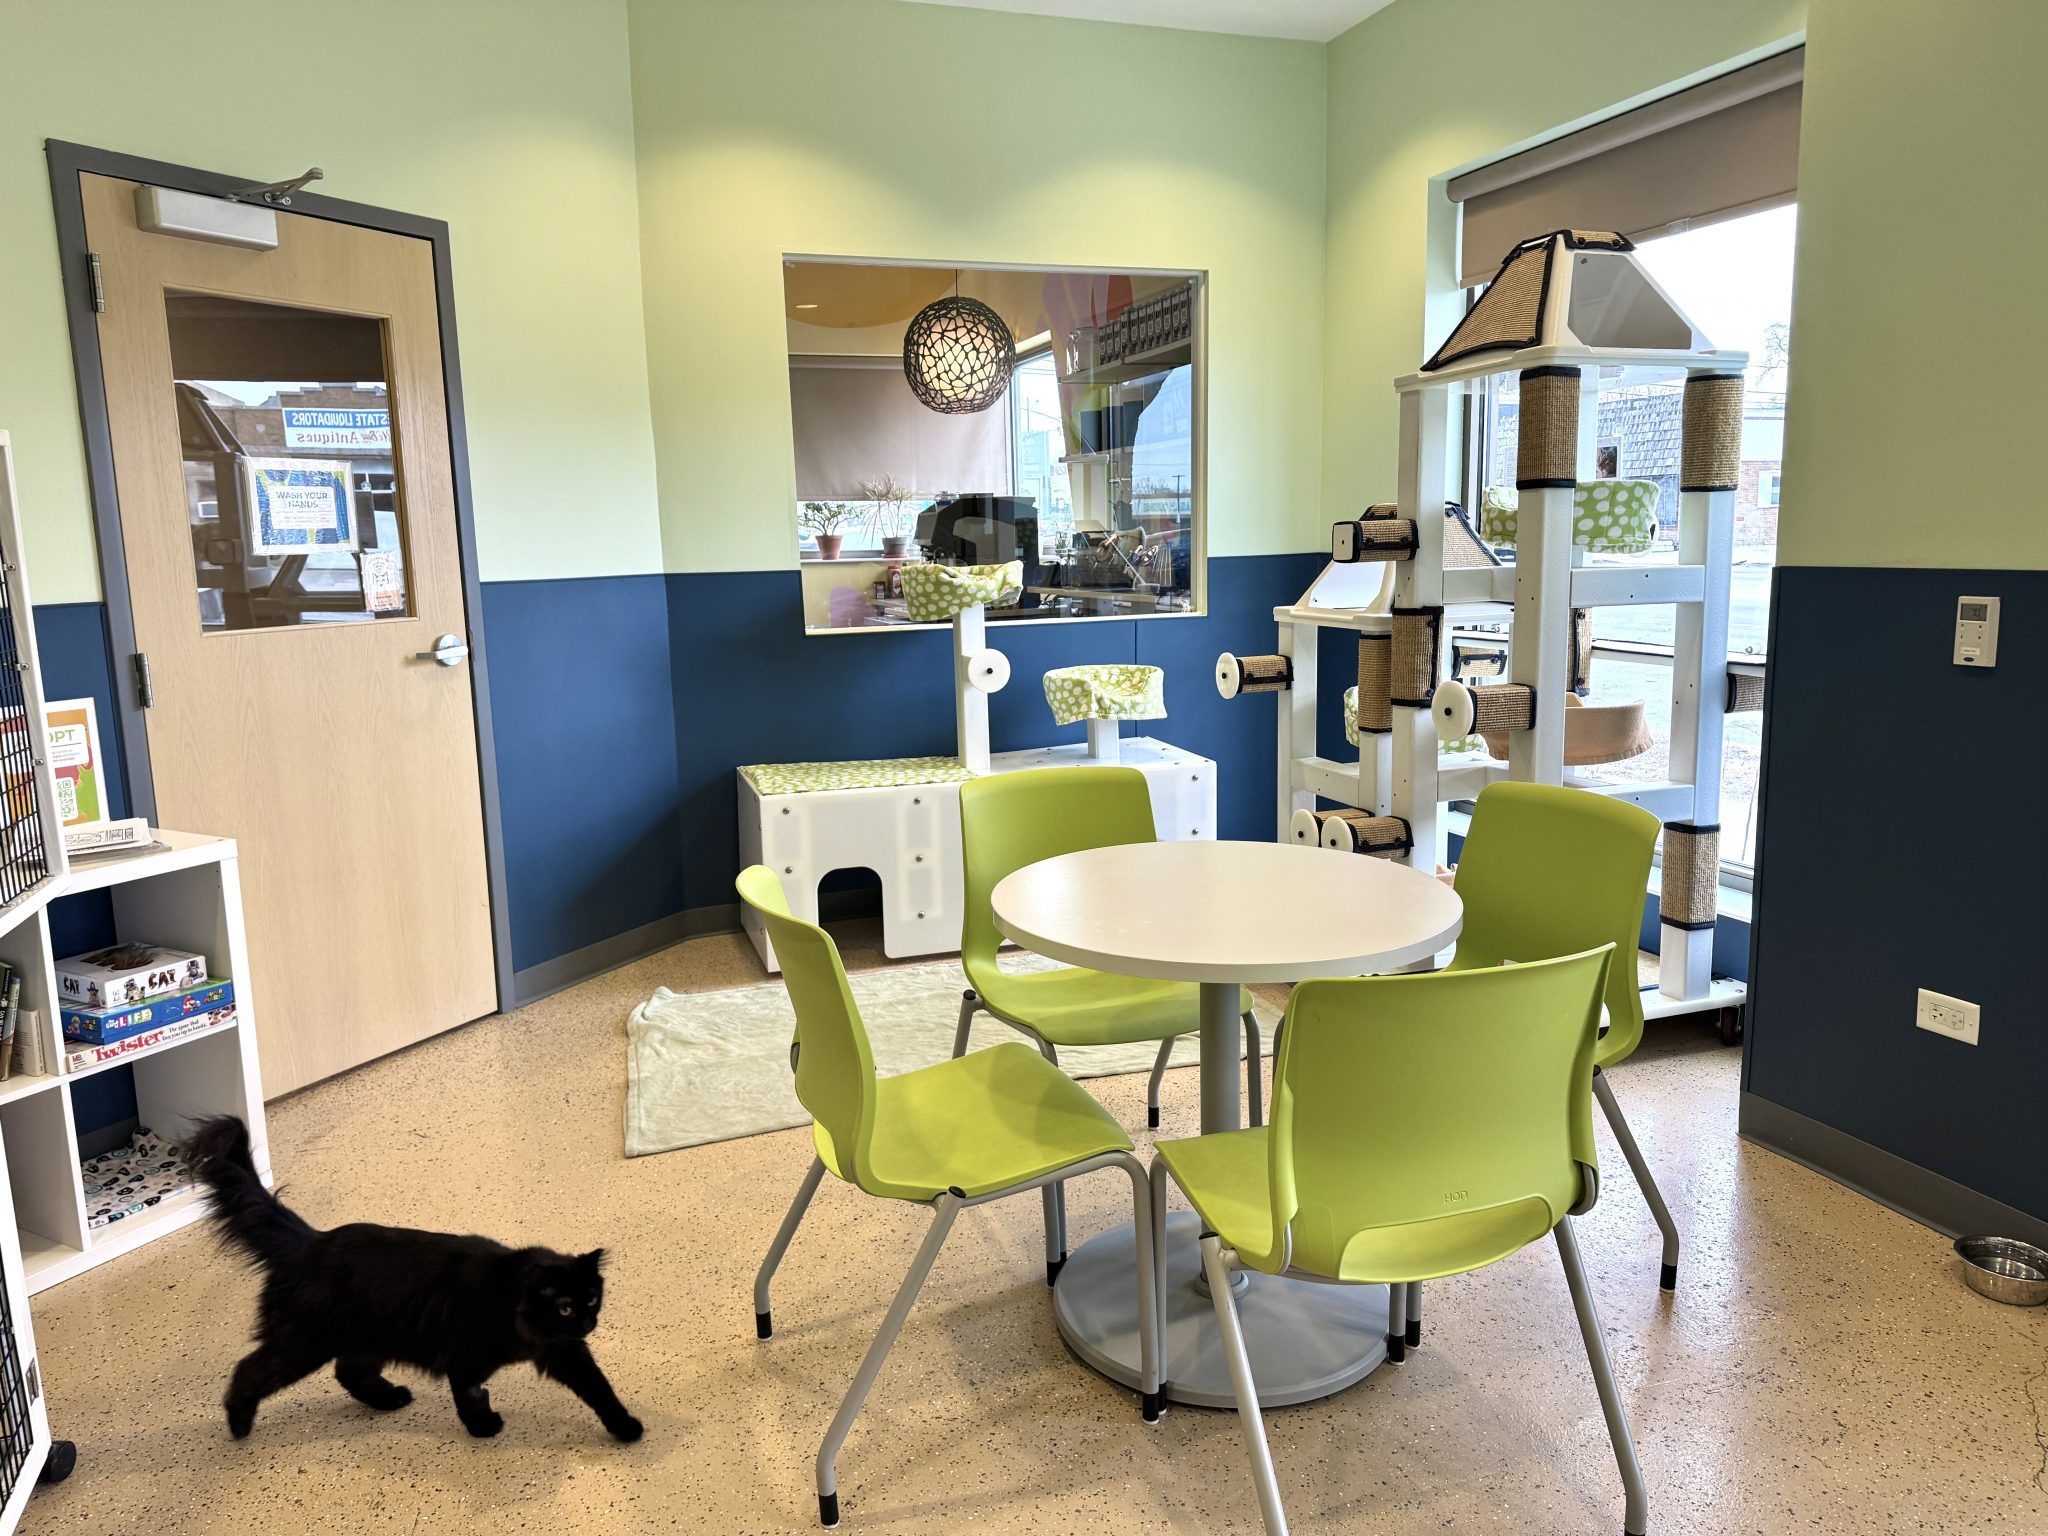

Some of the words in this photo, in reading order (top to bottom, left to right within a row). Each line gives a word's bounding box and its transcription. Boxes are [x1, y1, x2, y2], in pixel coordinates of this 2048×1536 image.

[276, 491, 303, 499] WASH
[148, 968, 176, 989] CAT
[119, 1008, 151, 1028] LIFE
[91, 1030, 164, 1062] Twister
